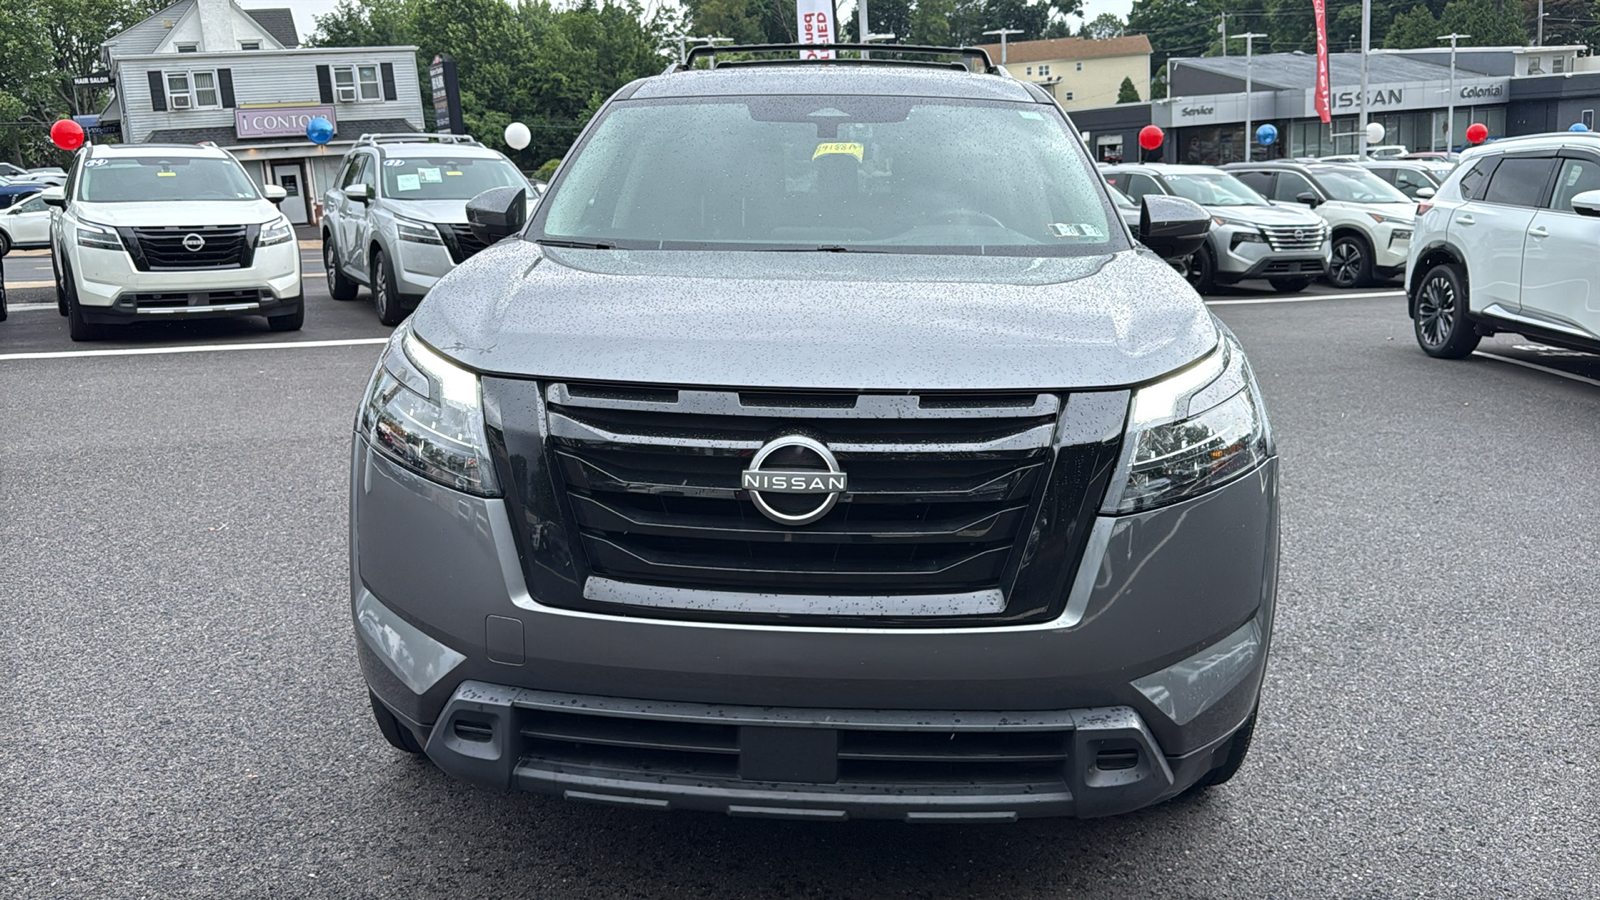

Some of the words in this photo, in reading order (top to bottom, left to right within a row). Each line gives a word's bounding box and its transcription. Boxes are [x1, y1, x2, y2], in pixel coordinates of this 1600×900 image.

[90, 76, 109, 84] SALON
[1332, 89, 1403, 109] ISSAN
[1460, 84, 1503, 99] Colonial
[1181, 105, 1214, 117] Service
[744, 474, 844, 490] NISSAN
